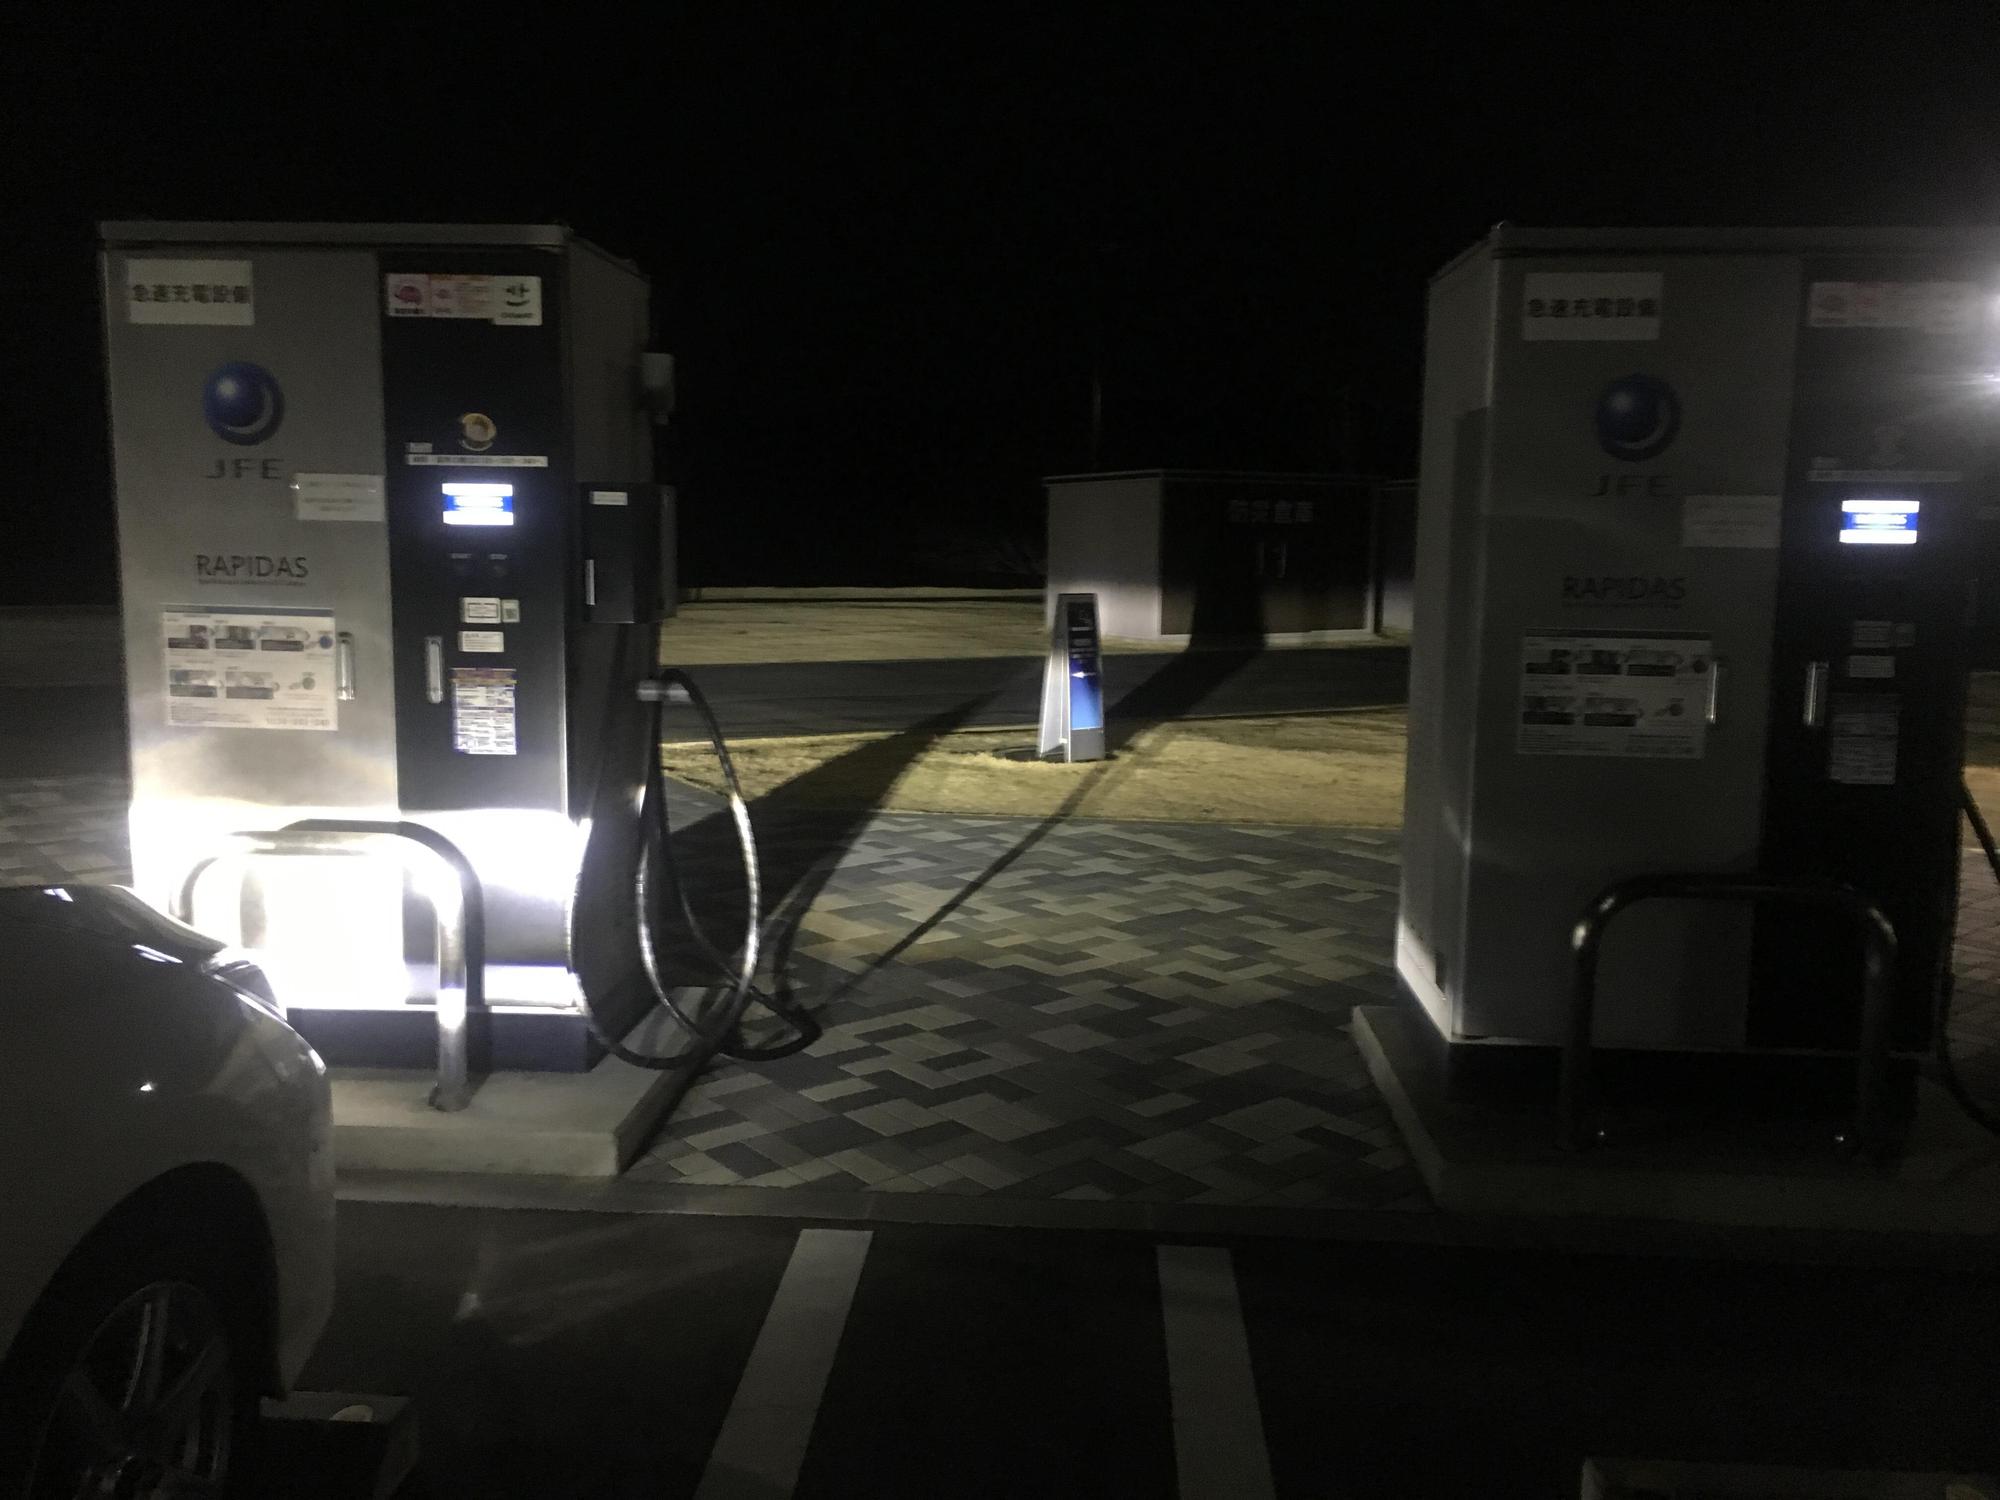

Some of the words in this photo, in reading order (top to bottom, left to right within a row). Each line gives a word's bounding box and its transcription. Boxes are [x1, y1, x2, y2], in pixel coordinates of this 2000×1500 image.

[206, 459, 285, 480] JFE
[196, 555, 309, 578] RAPIDAS
[1562, 576, 1686, 600] RAPIDAS
